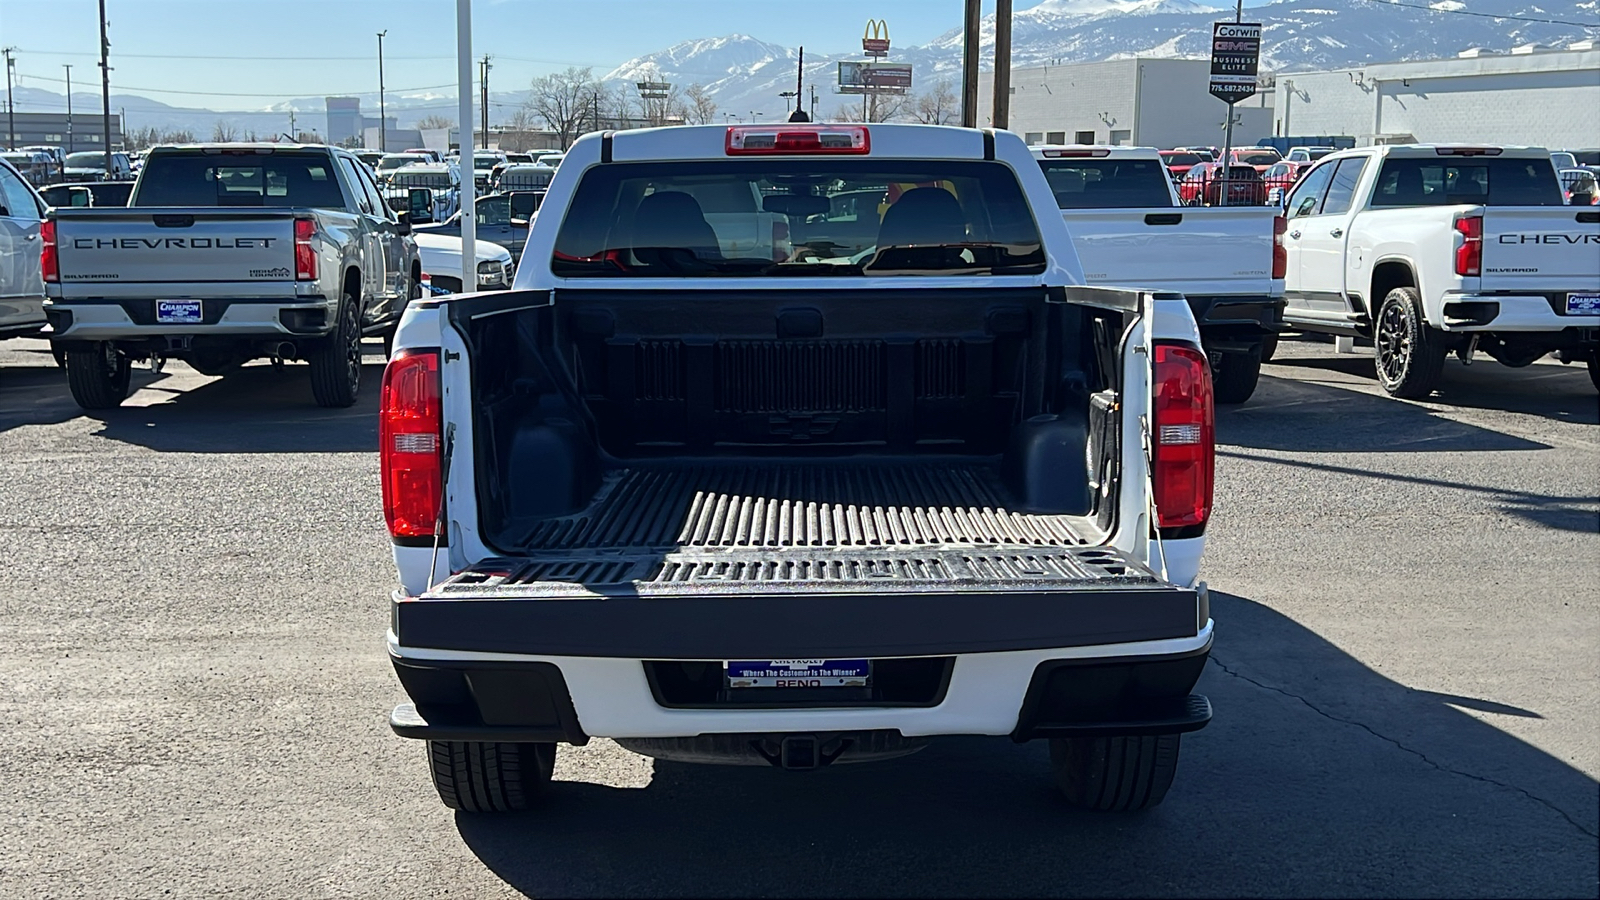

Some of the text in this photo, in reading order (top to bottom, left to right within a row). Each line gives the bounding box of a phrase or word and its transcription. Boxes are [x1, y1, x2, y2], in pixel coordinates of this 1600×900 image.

[1219, 27, 1260, 37] Corwin
[1215, 41, 1257, 51] GMC
[74, 238, 277, 249] CHEVROLET
[160, 303, 199, 311] CHAMPION
